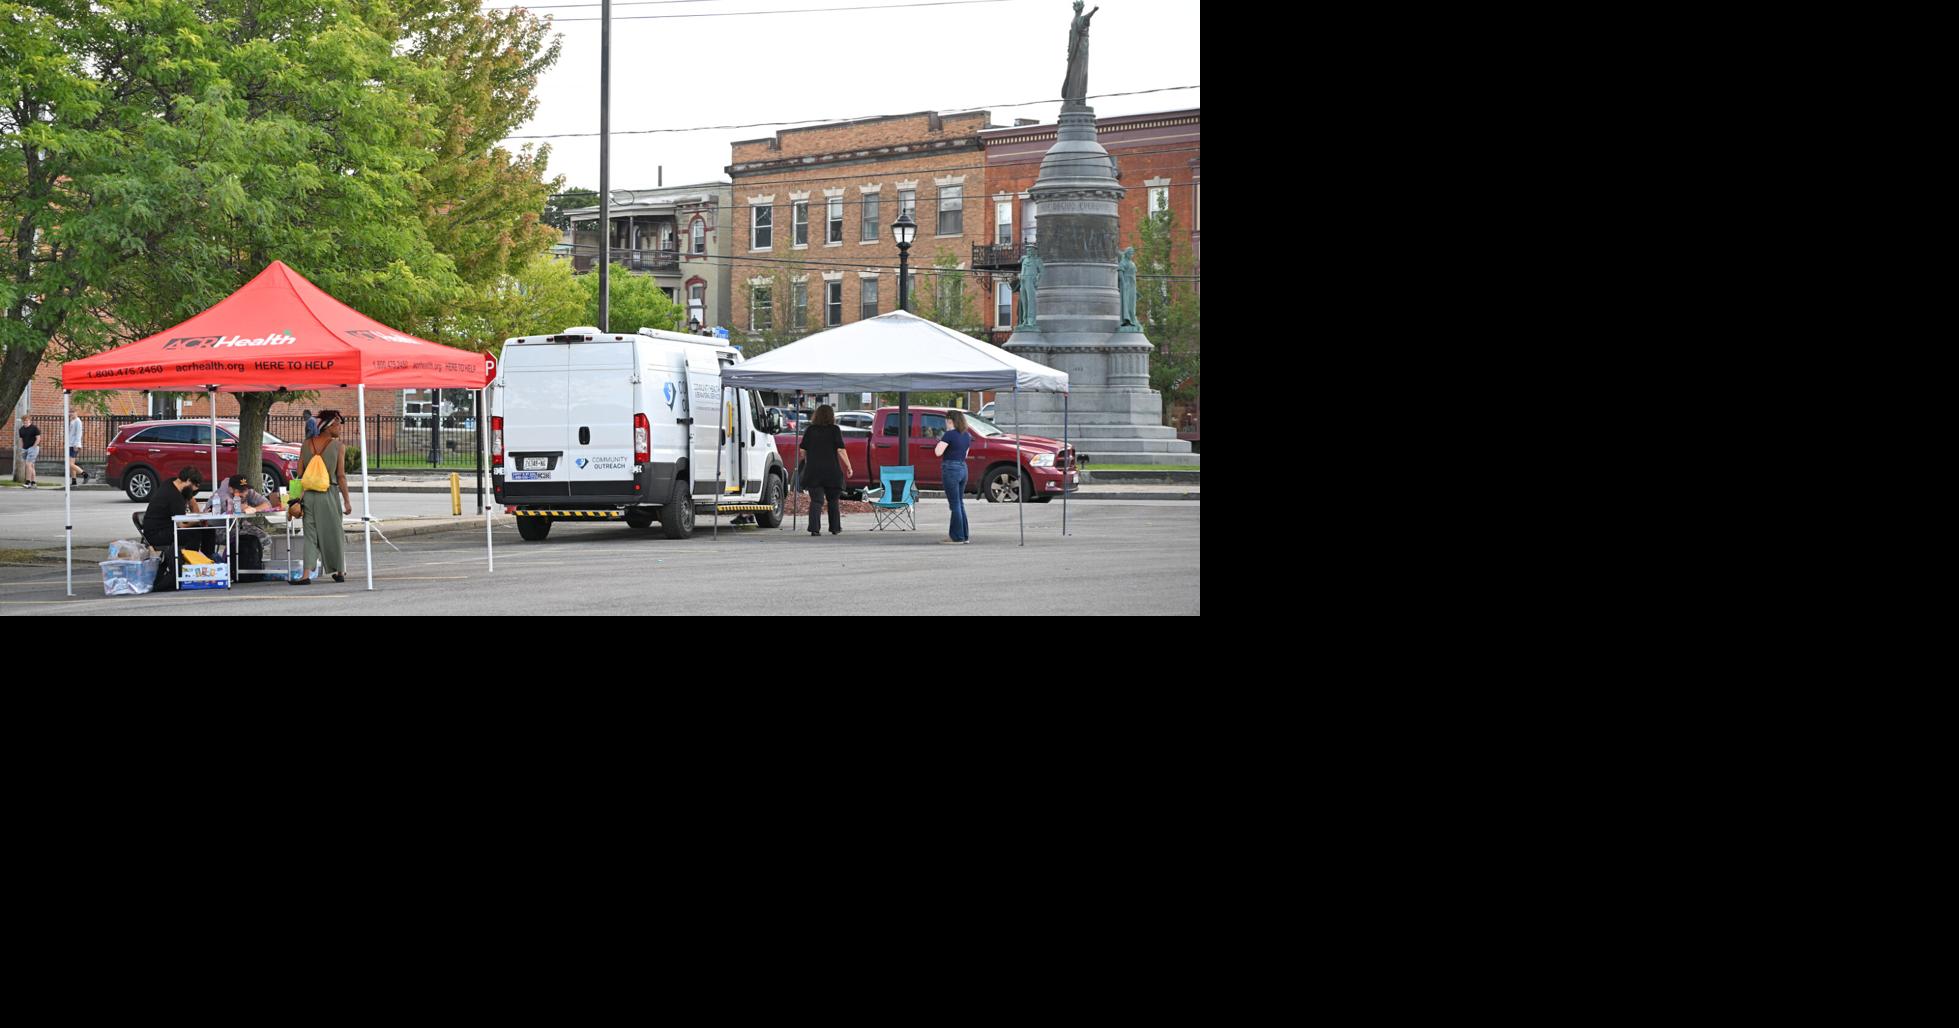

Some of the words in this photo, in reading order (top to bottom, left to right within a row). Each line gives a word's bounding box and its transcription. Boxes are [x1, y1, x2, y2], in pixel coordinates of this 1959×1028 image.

[175, 361, 245, 372] acrhealth.org
[254, 361, 285, 370] HERE
[287, 361, 302, 370] TO
[304, 360, 334, 370] HELP
